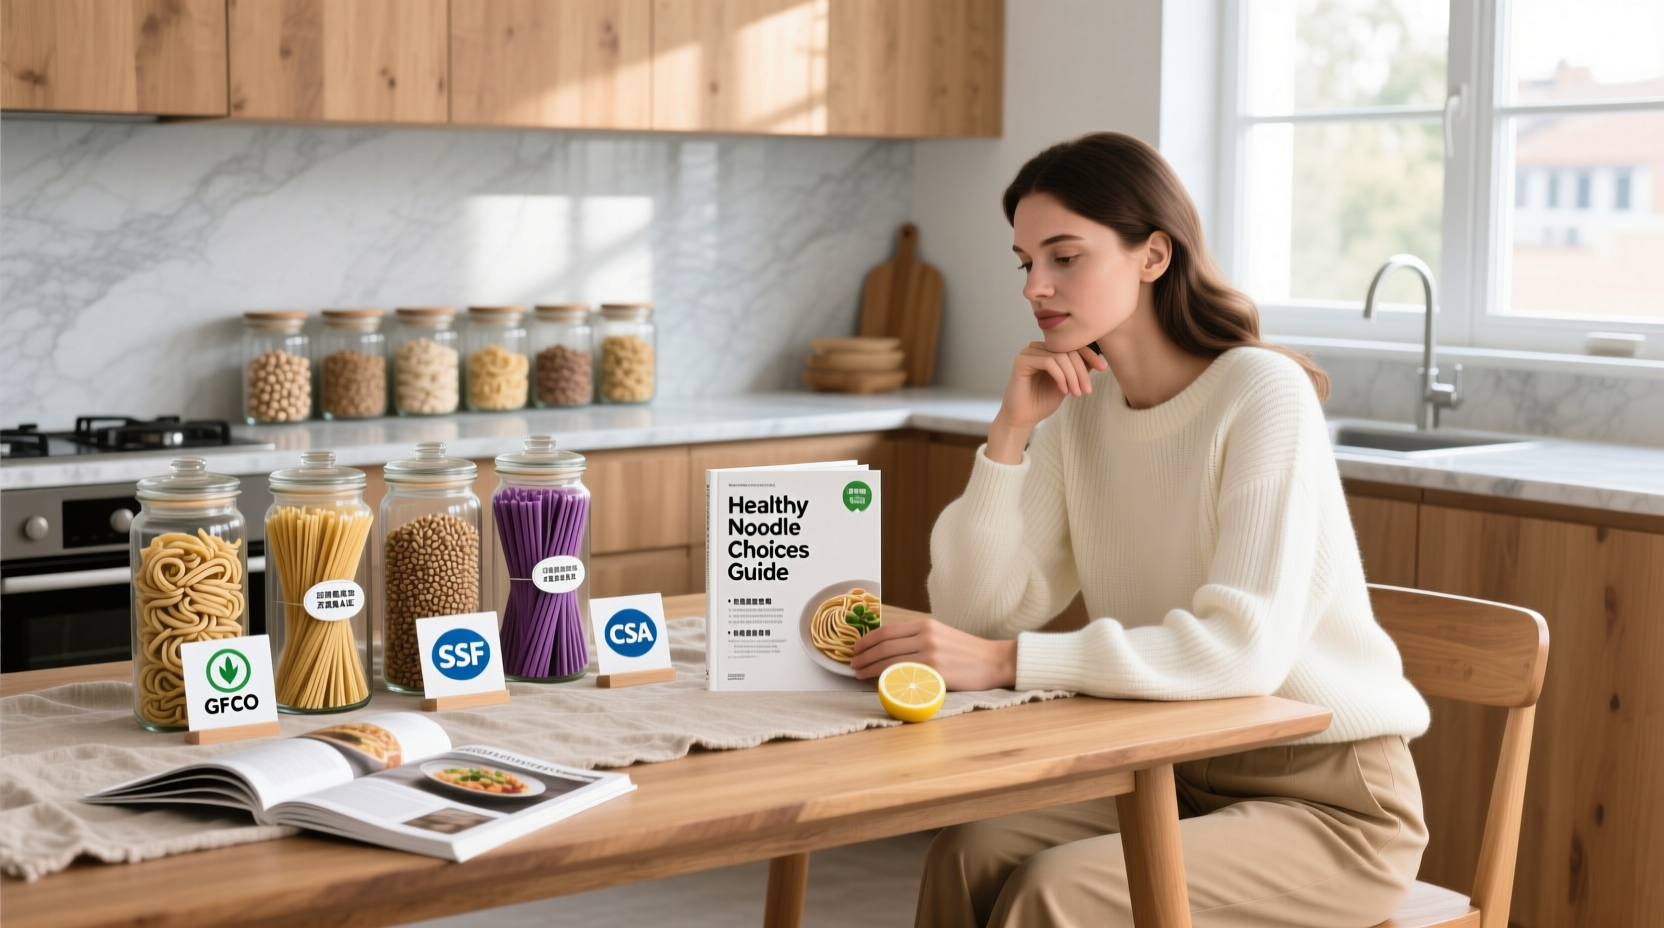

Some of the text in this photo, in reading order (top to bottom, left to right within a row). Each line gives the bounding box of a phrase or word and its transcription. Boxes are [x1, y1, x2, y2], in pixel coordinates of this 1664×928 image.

[728, 495, 809, 518] Healthy
[728, 517, 801, 536] Noodle
[727, 539, 810, 559] Choices
[727, 561, 789, 581] Guide
[609, 622, 654, 645] CSA
[439, 641, 484, 669] SSF
[204, 693, 259, 715] GFCO
